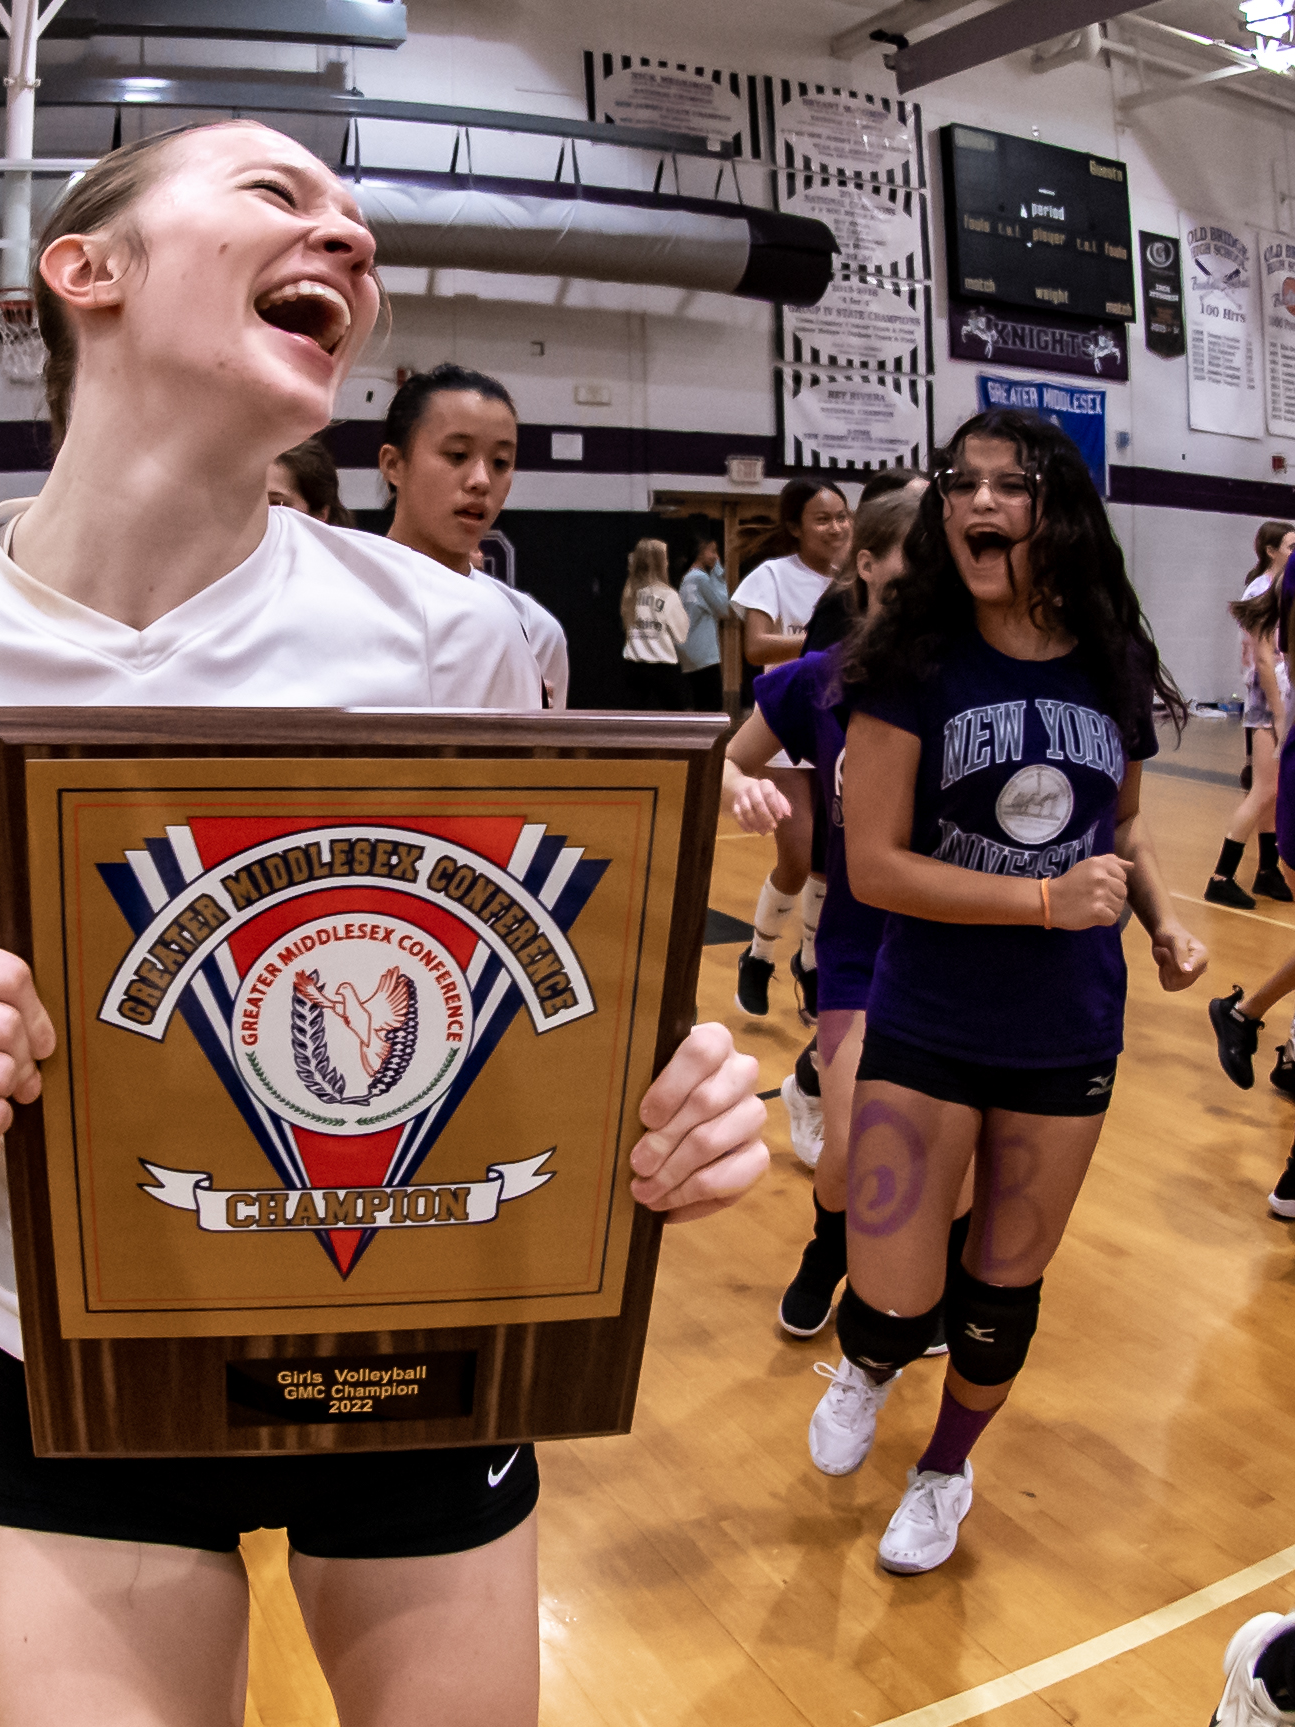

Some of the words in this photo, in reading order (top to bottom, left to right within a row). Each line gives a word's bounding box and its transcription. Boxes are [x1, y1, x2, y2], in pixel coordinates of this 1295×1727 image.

[1031, 203, 1065, 221] period
[1187, 227, 1207, 247] OLD
[1200, 303, 1220, 318] 100
[994, 321, 1096, 360] KNIGHTS
[988, 381, 1039, 408] GREATER
[1043, 386, 1103, 415] MIDDLESEX
[940, 699, 1027, 790] NEW
[116, 892, 232, 1026] GREATER
[220, 837, 426, 913] MIDDLESEX
[426, 854, 580, 1020] CONFERENCE
[240, 962, 283, 1047] GREATER
[277, 922, 396, 967] MIDDLESEX
[397, 933, 464, 1043] CONFERENCE
[225, 1186, 471, 1229] CHAMPION
[277, 1370, 323, 1385] Girls
[334, 1365, 427, 1385] Volleyball
[284, 1385, 325, 1400] GMC
[331, 1383, 419, 1400] Champion
[329, 1399, 373, 1414] 2022
